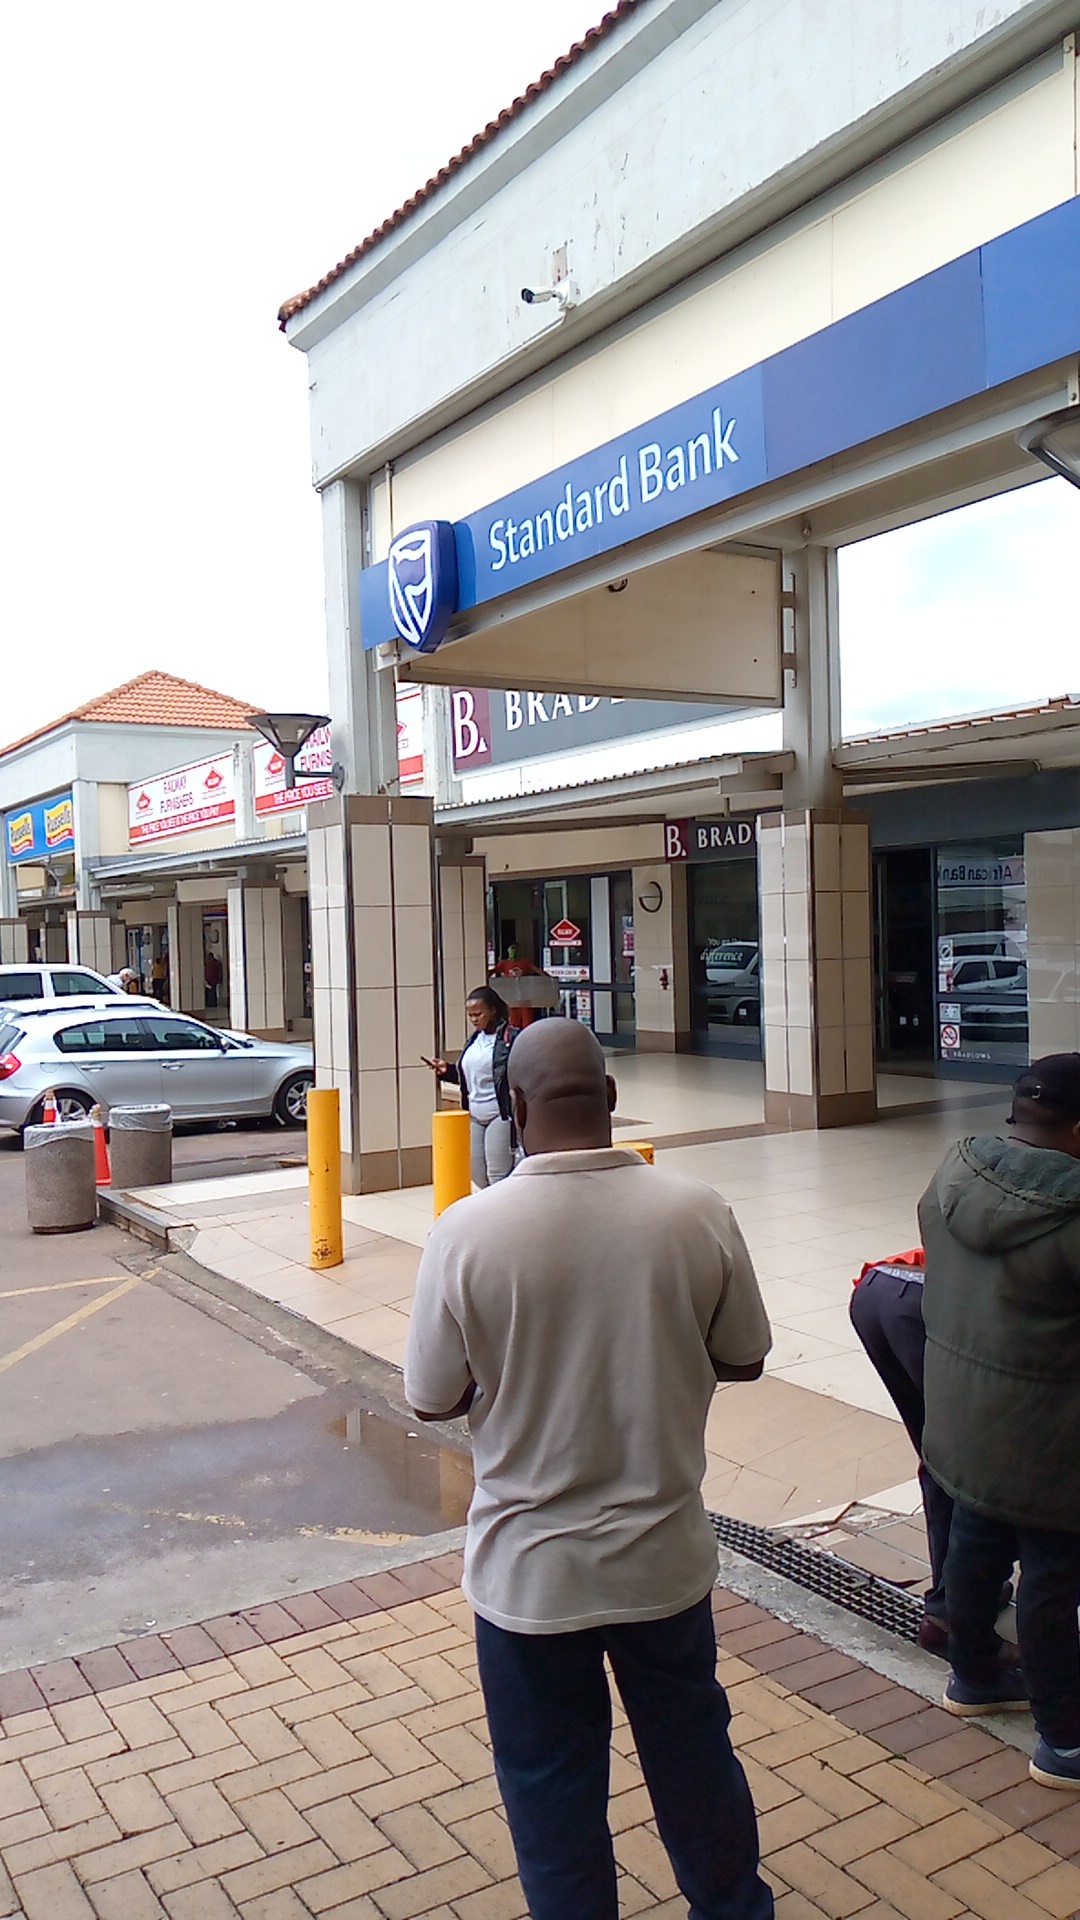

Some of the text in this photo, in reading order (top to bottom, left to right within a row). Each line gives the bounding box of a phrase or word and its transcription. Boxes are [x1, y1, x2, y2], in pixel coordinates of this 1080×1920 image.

[488, 406, 740, 571] Standard Bank
[698, 823, 752, 848] BRAD
